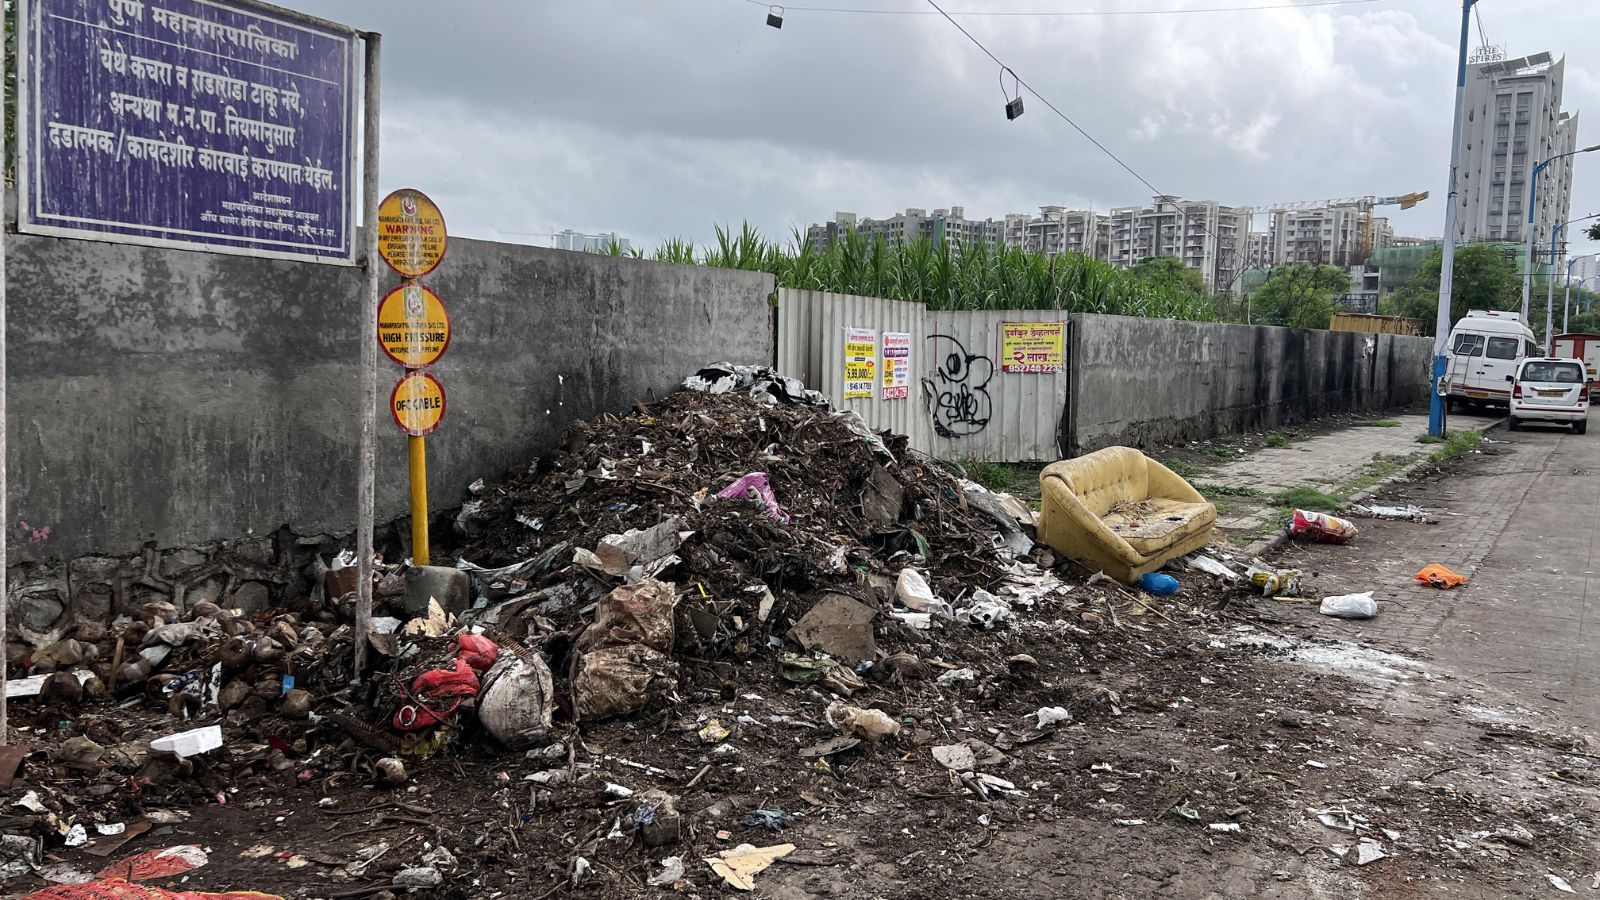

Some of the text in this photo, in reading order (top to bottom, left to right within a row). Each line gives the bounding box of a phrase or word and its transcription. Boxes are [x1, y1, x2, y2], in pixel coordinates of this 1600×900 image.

[151, 6, 297, 60] महानगरपालिका
[1471, 47, 1502, 63] THE SPIRES
[100, 38, 126, 76] येथे
[130, 55, 172, 87] कचरा
[176, 65, 188, 89] व
[191, 66, 247, 101] राडारोडा
[250, 82, 278, 117] टाकू
[109, 91, 162, 123] अन्यथा
[224, 105, 296, 152] नियमानुसार
[198, 146, 250, 181] कारवाई
[251, 157, 302, 184] करण्यात
[222, 200, 263, 215] महापालिका
[385, 224, 433, 234] WARNING
[383, 332, 402, 342] HIGH
